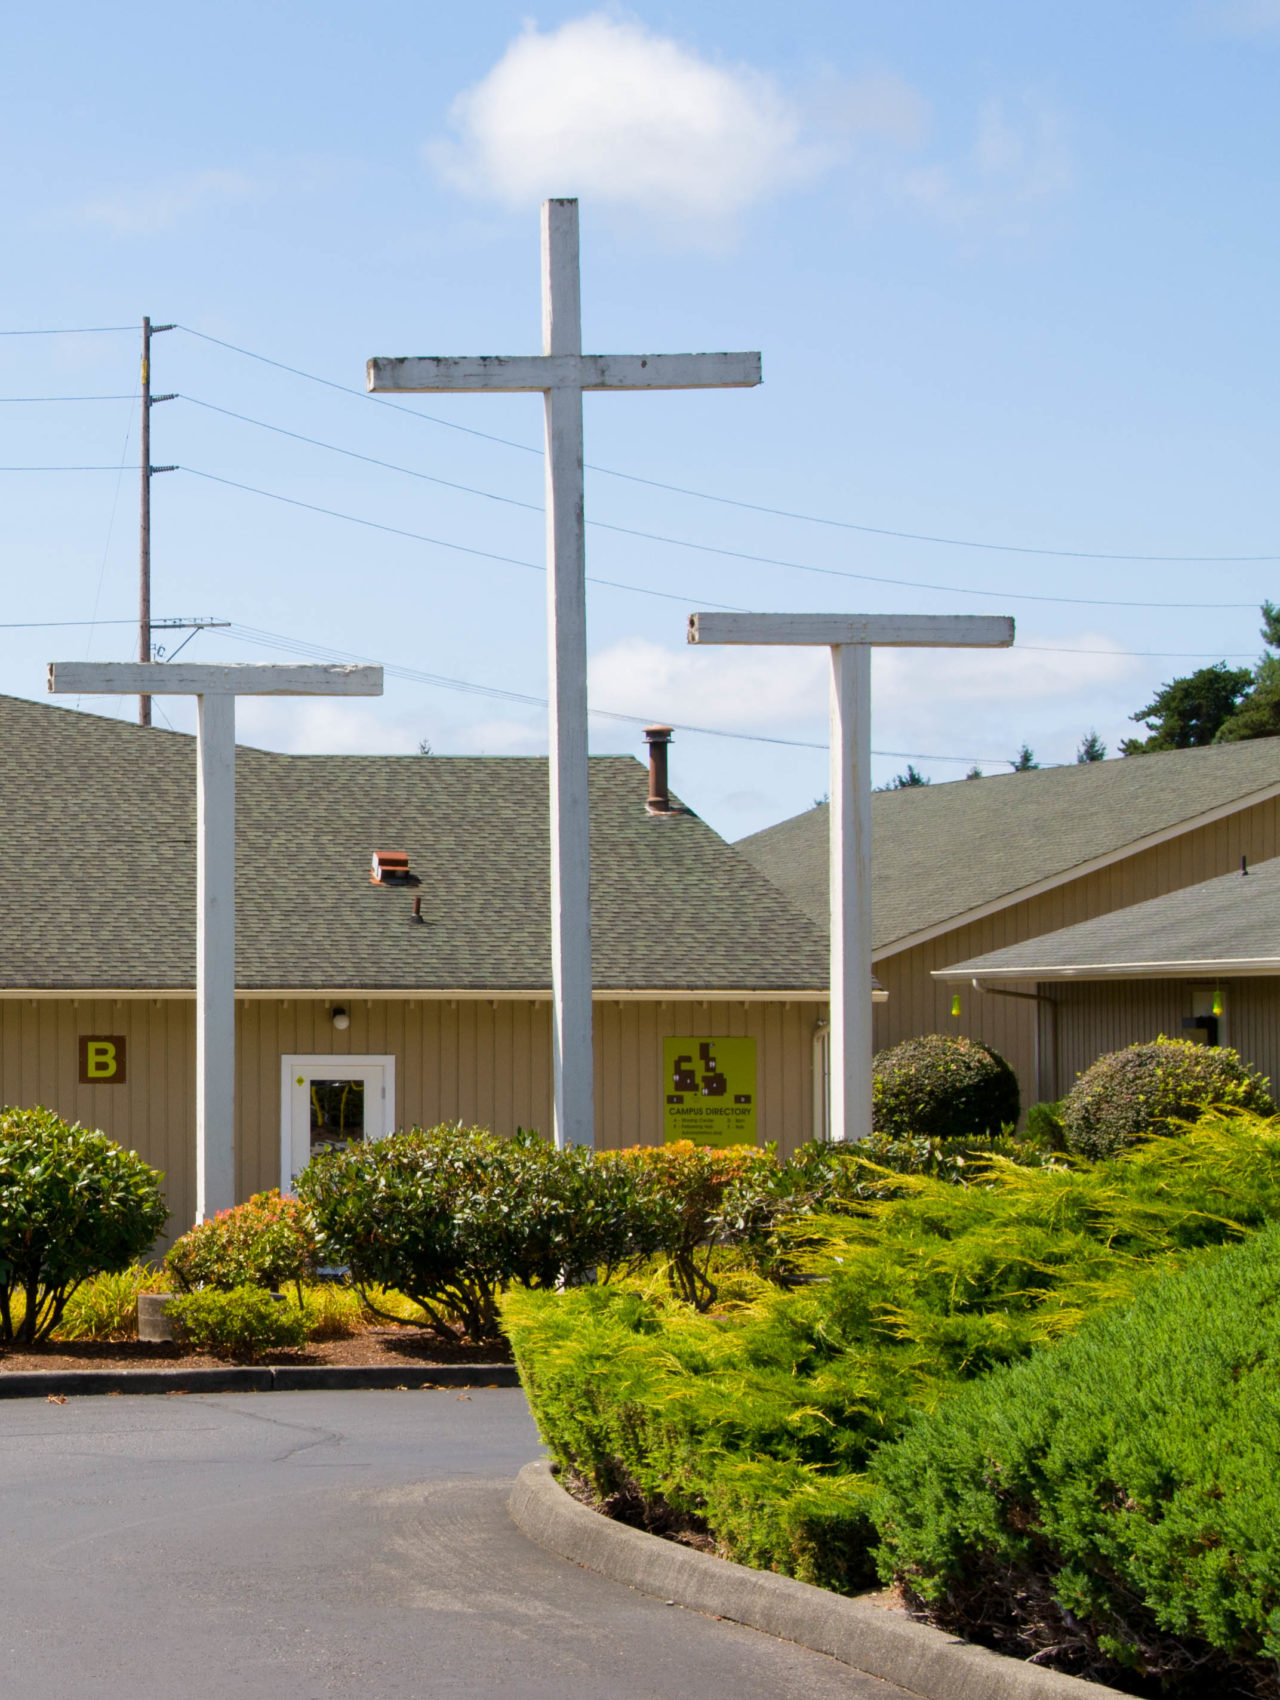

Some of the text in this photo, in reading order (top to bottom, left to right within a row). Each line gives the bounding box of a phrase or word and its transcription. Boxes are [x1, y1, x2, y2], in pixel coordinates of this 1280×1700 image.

[87, 1041, 117, 1078] B
[669, 1107, 752, 1116] CAMPUS DIRECTORY
